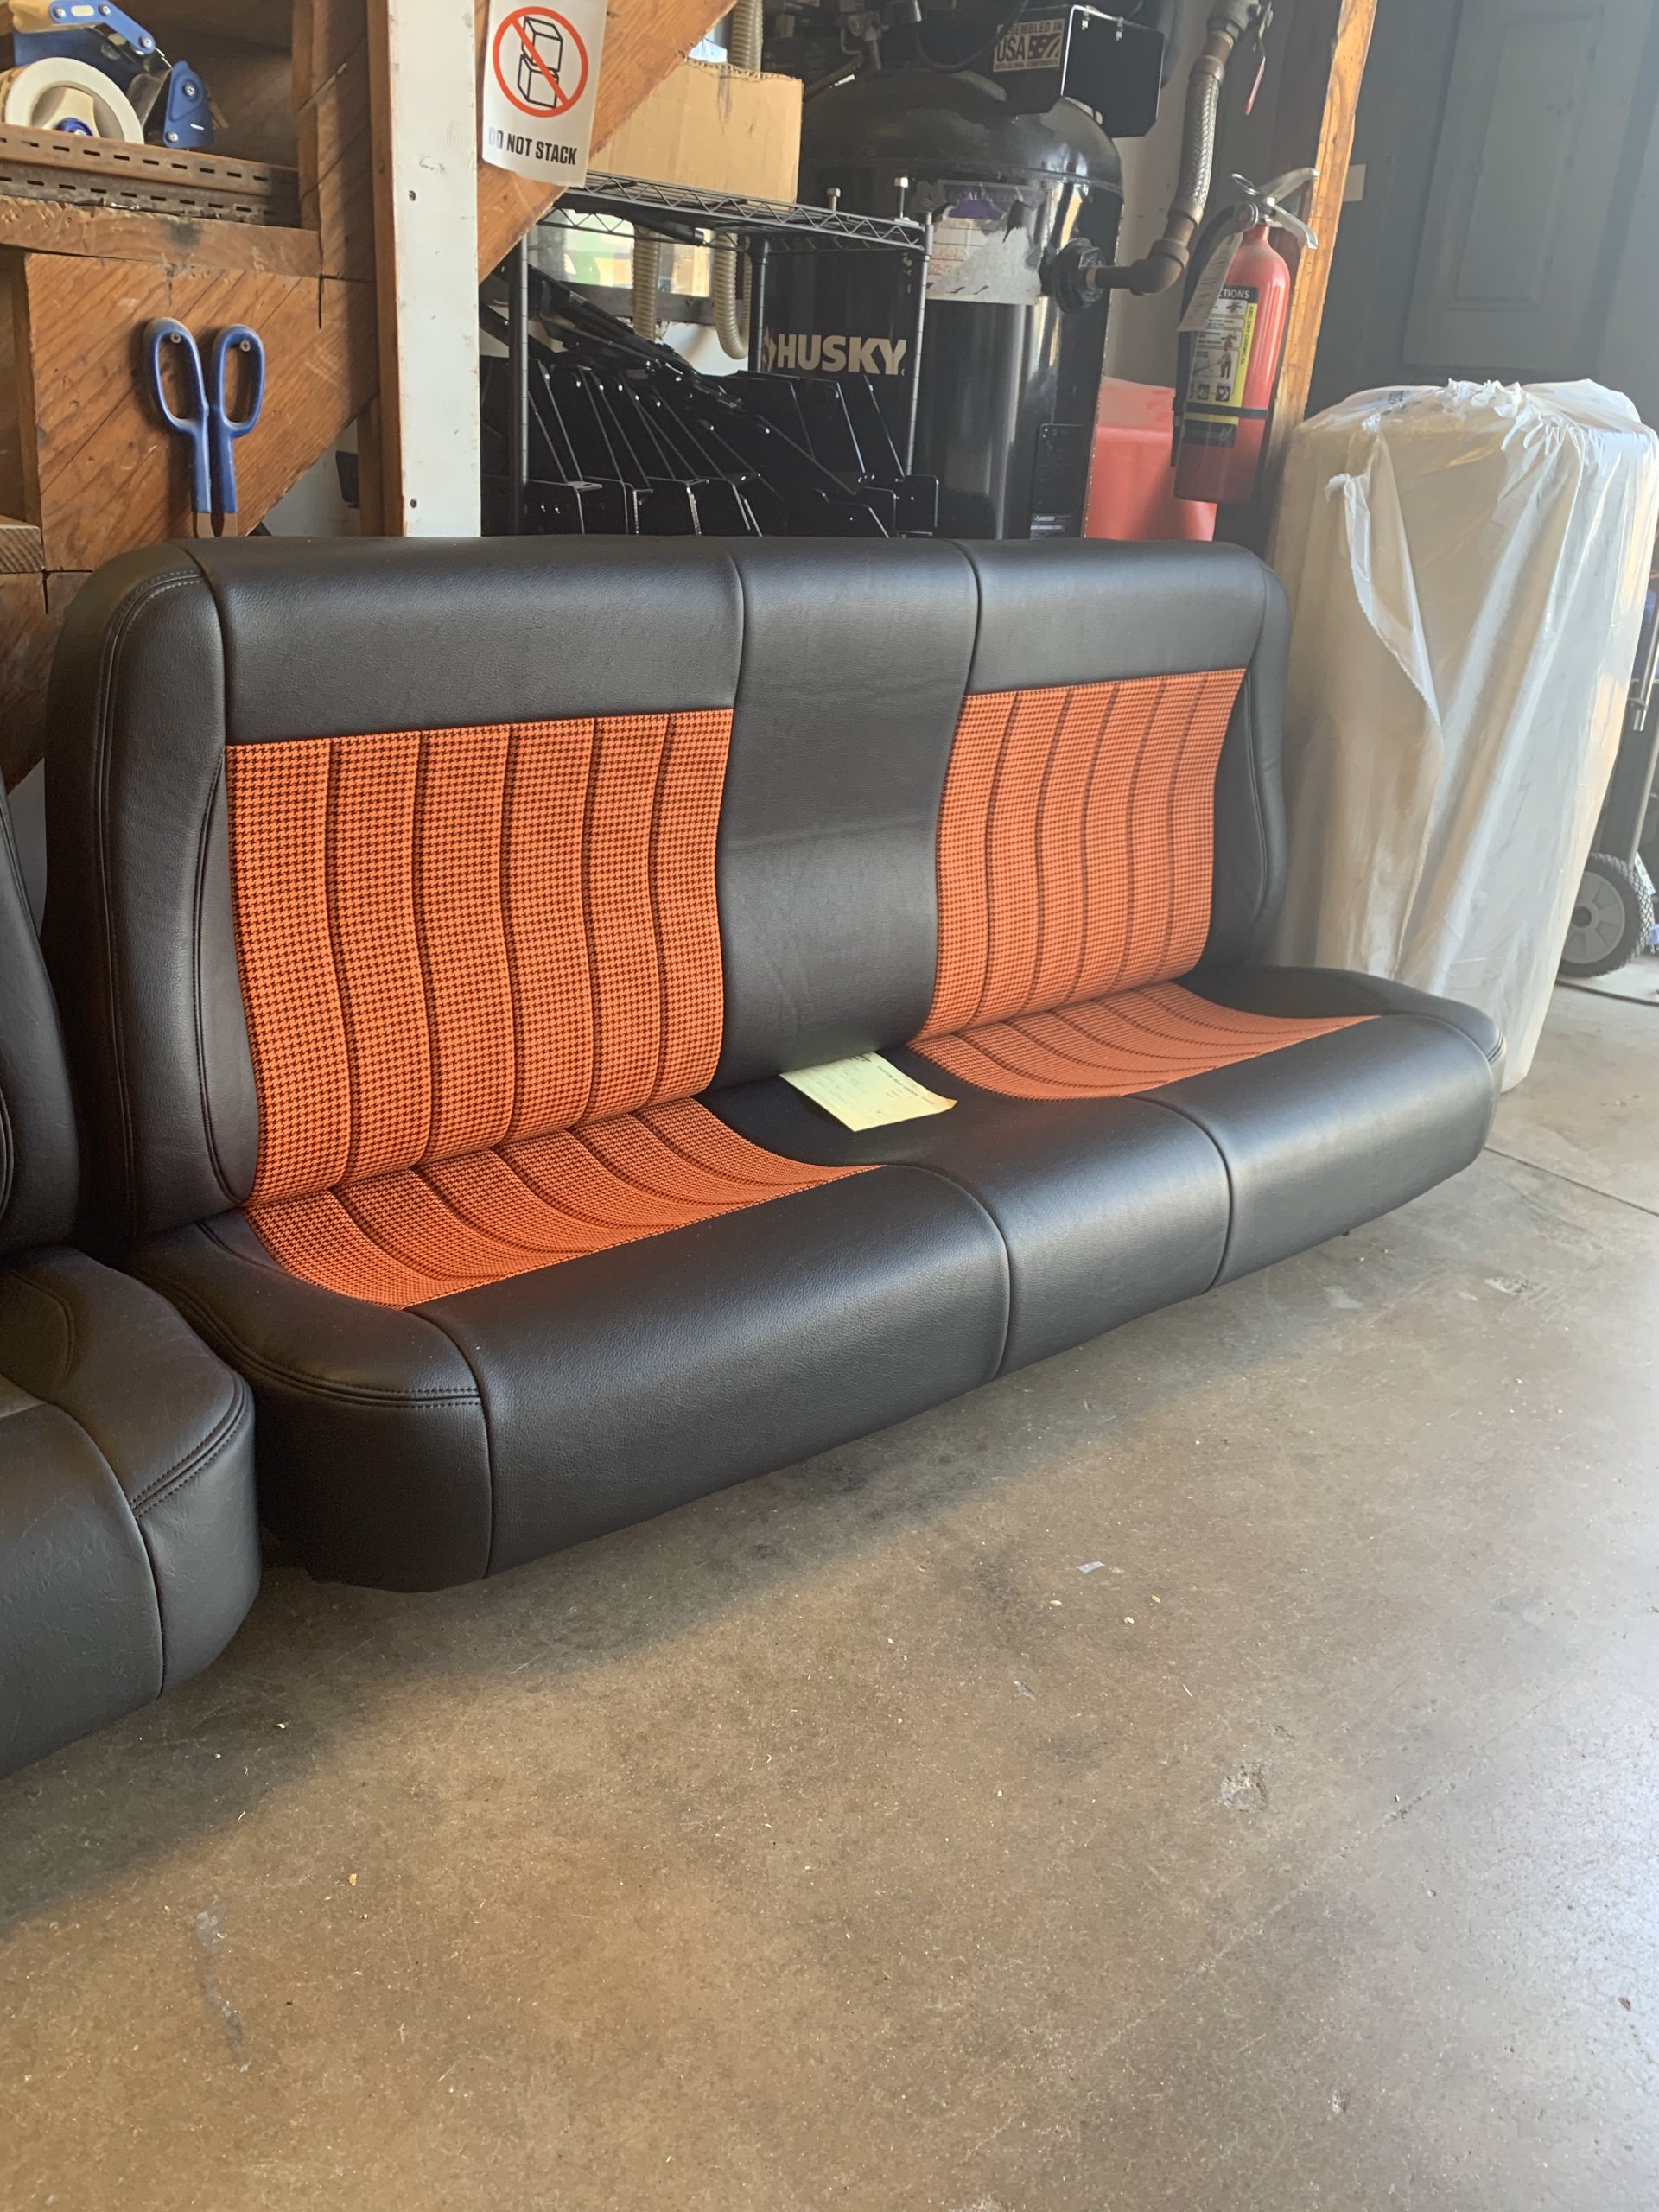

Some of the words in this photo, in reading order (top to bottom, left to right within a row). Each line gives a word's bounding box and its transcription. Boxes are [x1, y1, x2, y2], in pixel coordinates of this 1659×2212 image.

[1001, 22, 1051, 35] SEMBLED
[997, 36, 1026, 61] USA
[488, 127, 504, 149] DO
[506, 132, 532, 157] NOT
[535, 140, 578, 166] STACK
[777, 333, 907, 376] HUSKY
